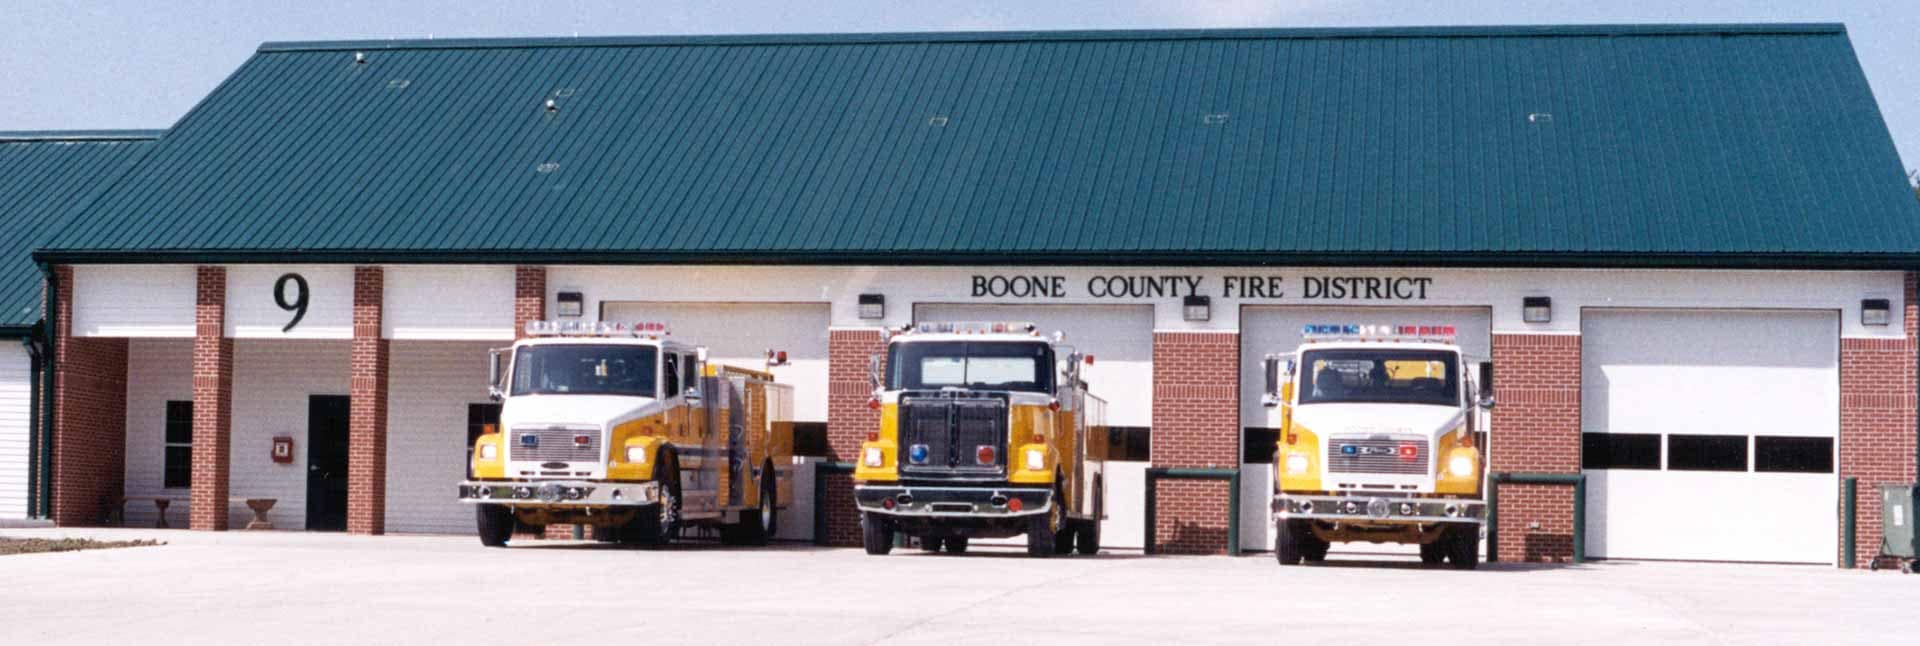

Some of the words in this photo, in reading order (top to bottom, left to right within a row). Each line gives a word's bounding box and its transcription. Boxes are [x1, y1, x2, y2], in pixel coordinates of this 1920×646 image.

[273, 273, 310, 333] 9
[971, 275, 1066, 298] BOONE
[1087, 275, 1204, 298] COUNTY
[1222, 275, 1285, 298] FIRE
[1302, 276, 1433, 300] DISTRICT
